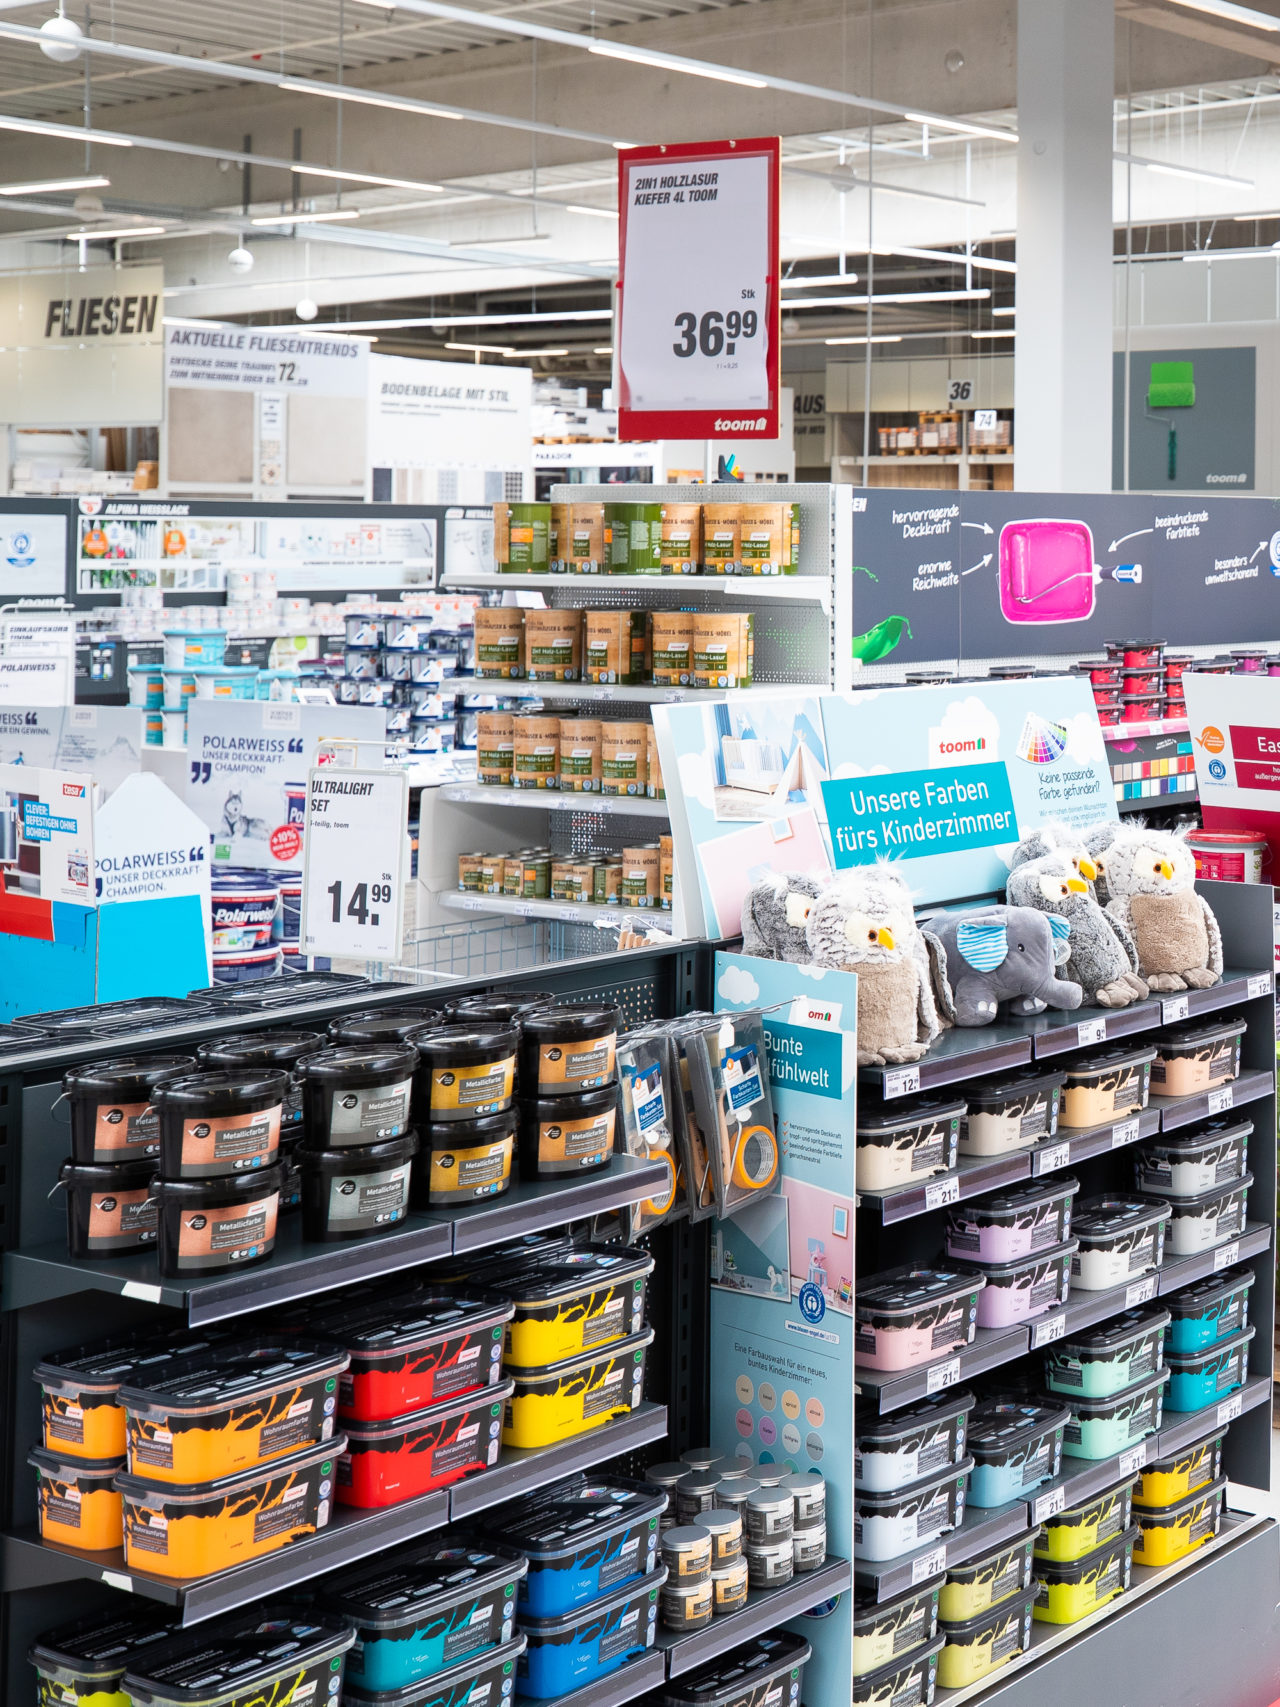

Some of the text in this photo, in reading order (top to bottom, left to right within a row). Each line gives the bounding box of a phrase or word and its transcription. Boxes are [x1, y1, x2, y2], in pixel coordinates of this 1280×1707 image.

[635, 173, 718, 190] 2IN1 HOLZLASUR
[634, 188, 718, 205] KIEFER 4L TOOM
[741, 289, 755, 299] Stk
[45, 295, 158, 338] FLIESEN
[672, 309, 758, 358] 36.99
[170, 330, 358, 358] AKTUELLE FLIESENTRENDS
[279, 363, 296, 381] 72
[466, 388, 485, 401] MIT
[488, 390, 510, 402] STIL
[949, 382, 971, 400] 36
[714, 418, 755, 431] toom
[978, 413, 993, 427] 74
[1206, 473, 1238, 484] toom
[892, 504, 960, 525] hervorragende
[1154, 510, 1209, 529] beeindruckende
[903, 521, 951, 540] Deckkraft
[1166, 526, 1200, 540] Farbtiefe
[918, 560, 951, 576] enorme
[1214, 555, 1248, 569] besonders
[912, 575, 959, 592] Reichweite
[1205, 567, 1259, 586] umweltschonend
[203, 735, 285, 752] POLARWEISS
[939, 738, 976, 754] toom
[202, 751, 285, 764] UNSER DECKKRAFT-
[215, 762, 266, 774] CHAMPION!
[1038, 768, 1095, 785] Keine passende
[64, 785, 80, 796] tesa
[311, 780, 374, 796] ULTRALIGHT
[1039, 787, 1062, 800] Farbe
[311, 799, 330, 812] SET
[850, 780, 989, 816] Unsere Farben
[26, 803, 48, 816] CLEVER:
[26, 816, 77, 832] BEFESTIGEN OHNE
[334, 821, 349, 829] toom
[836, 827, 878, 852] fürs
[882, 809, 1012, 846] Kinderzimmer
[26, 827, 50, 839] BOHREN
[106, 872, 139, 885] UNSER
[382, 873, 392, 881] Stk
[328, 880, 392, 926] 14.99
[764, 1031, 804, 1057] Bunte
[572, 1051, 605, 1063] Metallicfarbe
[465, 1075, 502, 1088] Metallicfarbe
[368, 1096, 402, 1110] Metallicfarbe
[223, 1126, 265, 1141] Metallicfarbe
[790, 1123, 842, 1139] hervorragende Deckkraft
[465, 1156, 501, 1169] Metallicfarbe
[219, 1216, 262, 1232] Metallicfarbe
[735, 1343, 747, 1354] Eine
[748, 1346, 786, 1367] Farbauswahl
[787, 1358, 796, 1369] für
[797, 1362, 806, 1371] ein
[748, 1358, 768, 1372] buntes
[436, 1361, 477, 1380] Wohnraumfarbe
[263, 1414, 310, 1436] Wohnraumfarbe
[258, 1499, 304, 1523] Wohnraumfarbe
[602, 1551, 637, 1572] Wohnraumfarbe
[448, 1620, 490, 1644] Wohnraumfarbe
